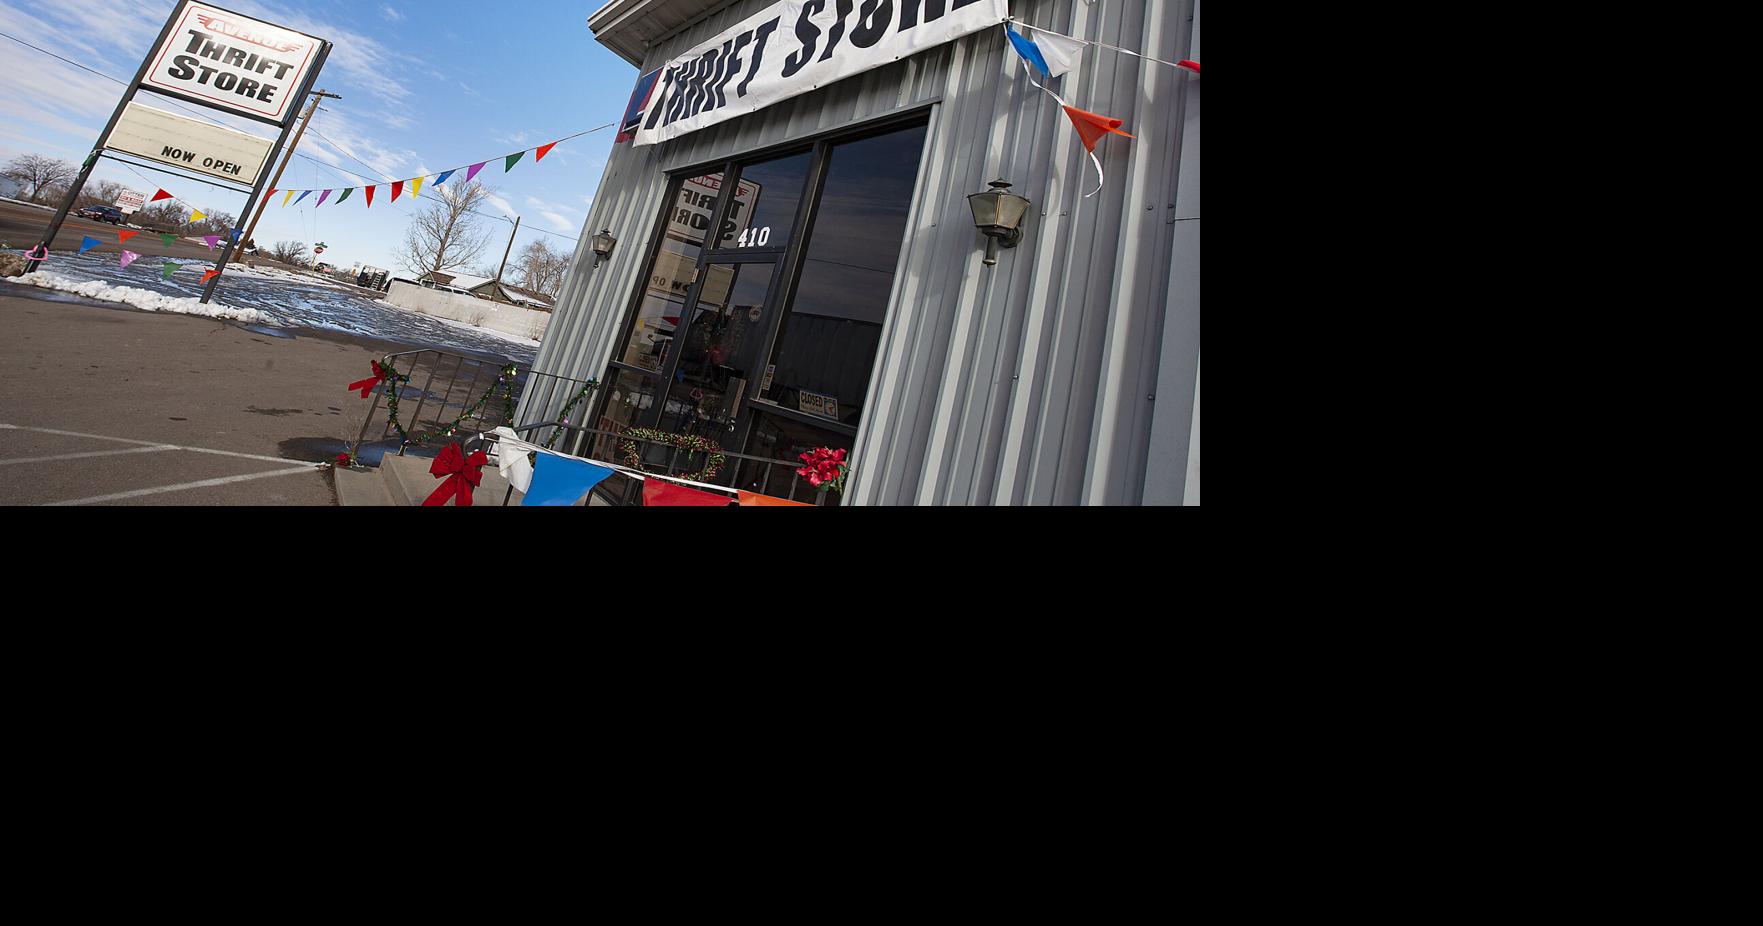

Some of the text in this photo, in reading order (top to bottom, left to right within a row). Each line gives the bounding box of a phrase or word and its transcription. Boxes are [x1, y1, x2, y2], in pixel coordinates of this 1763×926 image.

[185, 29, 294, 80] THRIFT
[644, 15, 780, 130] THRIFT
[168, 54, 278, 103] STORE
[161, 145, 242, 175] NOW OPEN
[738, 226, 771, 248] 410
[801, 391, 823, 408] CLOSED
